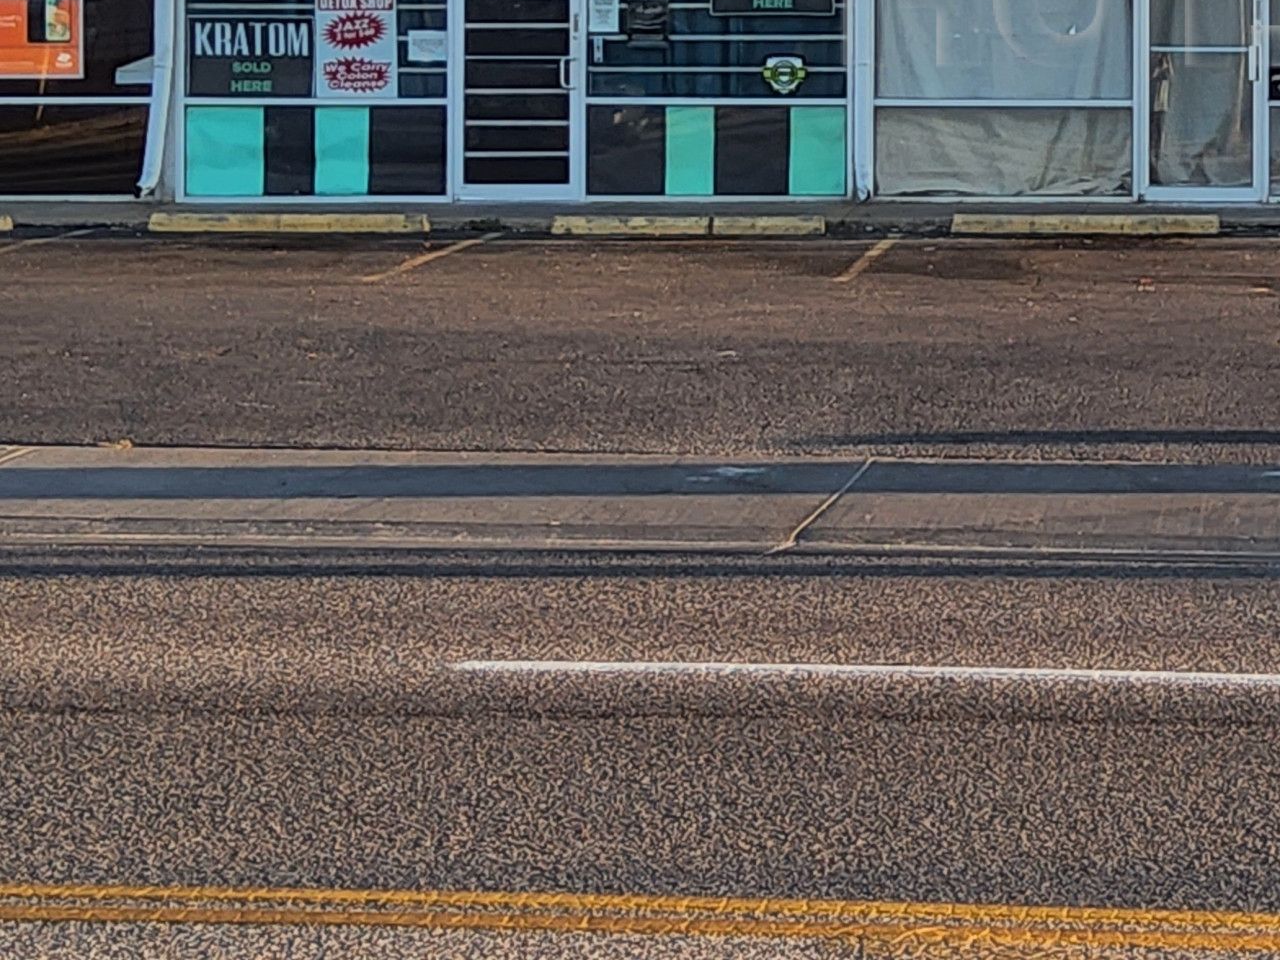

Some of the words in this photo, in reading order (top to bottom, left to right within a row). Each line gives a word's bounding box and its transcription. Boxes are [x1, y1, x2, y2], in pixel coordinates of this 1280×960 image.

[194, 22, 310, 57] KRATOM
[231, 62, 272, 74] SOLD
[325, 62, 346, 73] We
[350, 62, 389, 73] Carry
[336, 70, 378, 80] Colon
[229, 80, 273, 93] HERE
[329, 79, 386, 90] Cleanse
